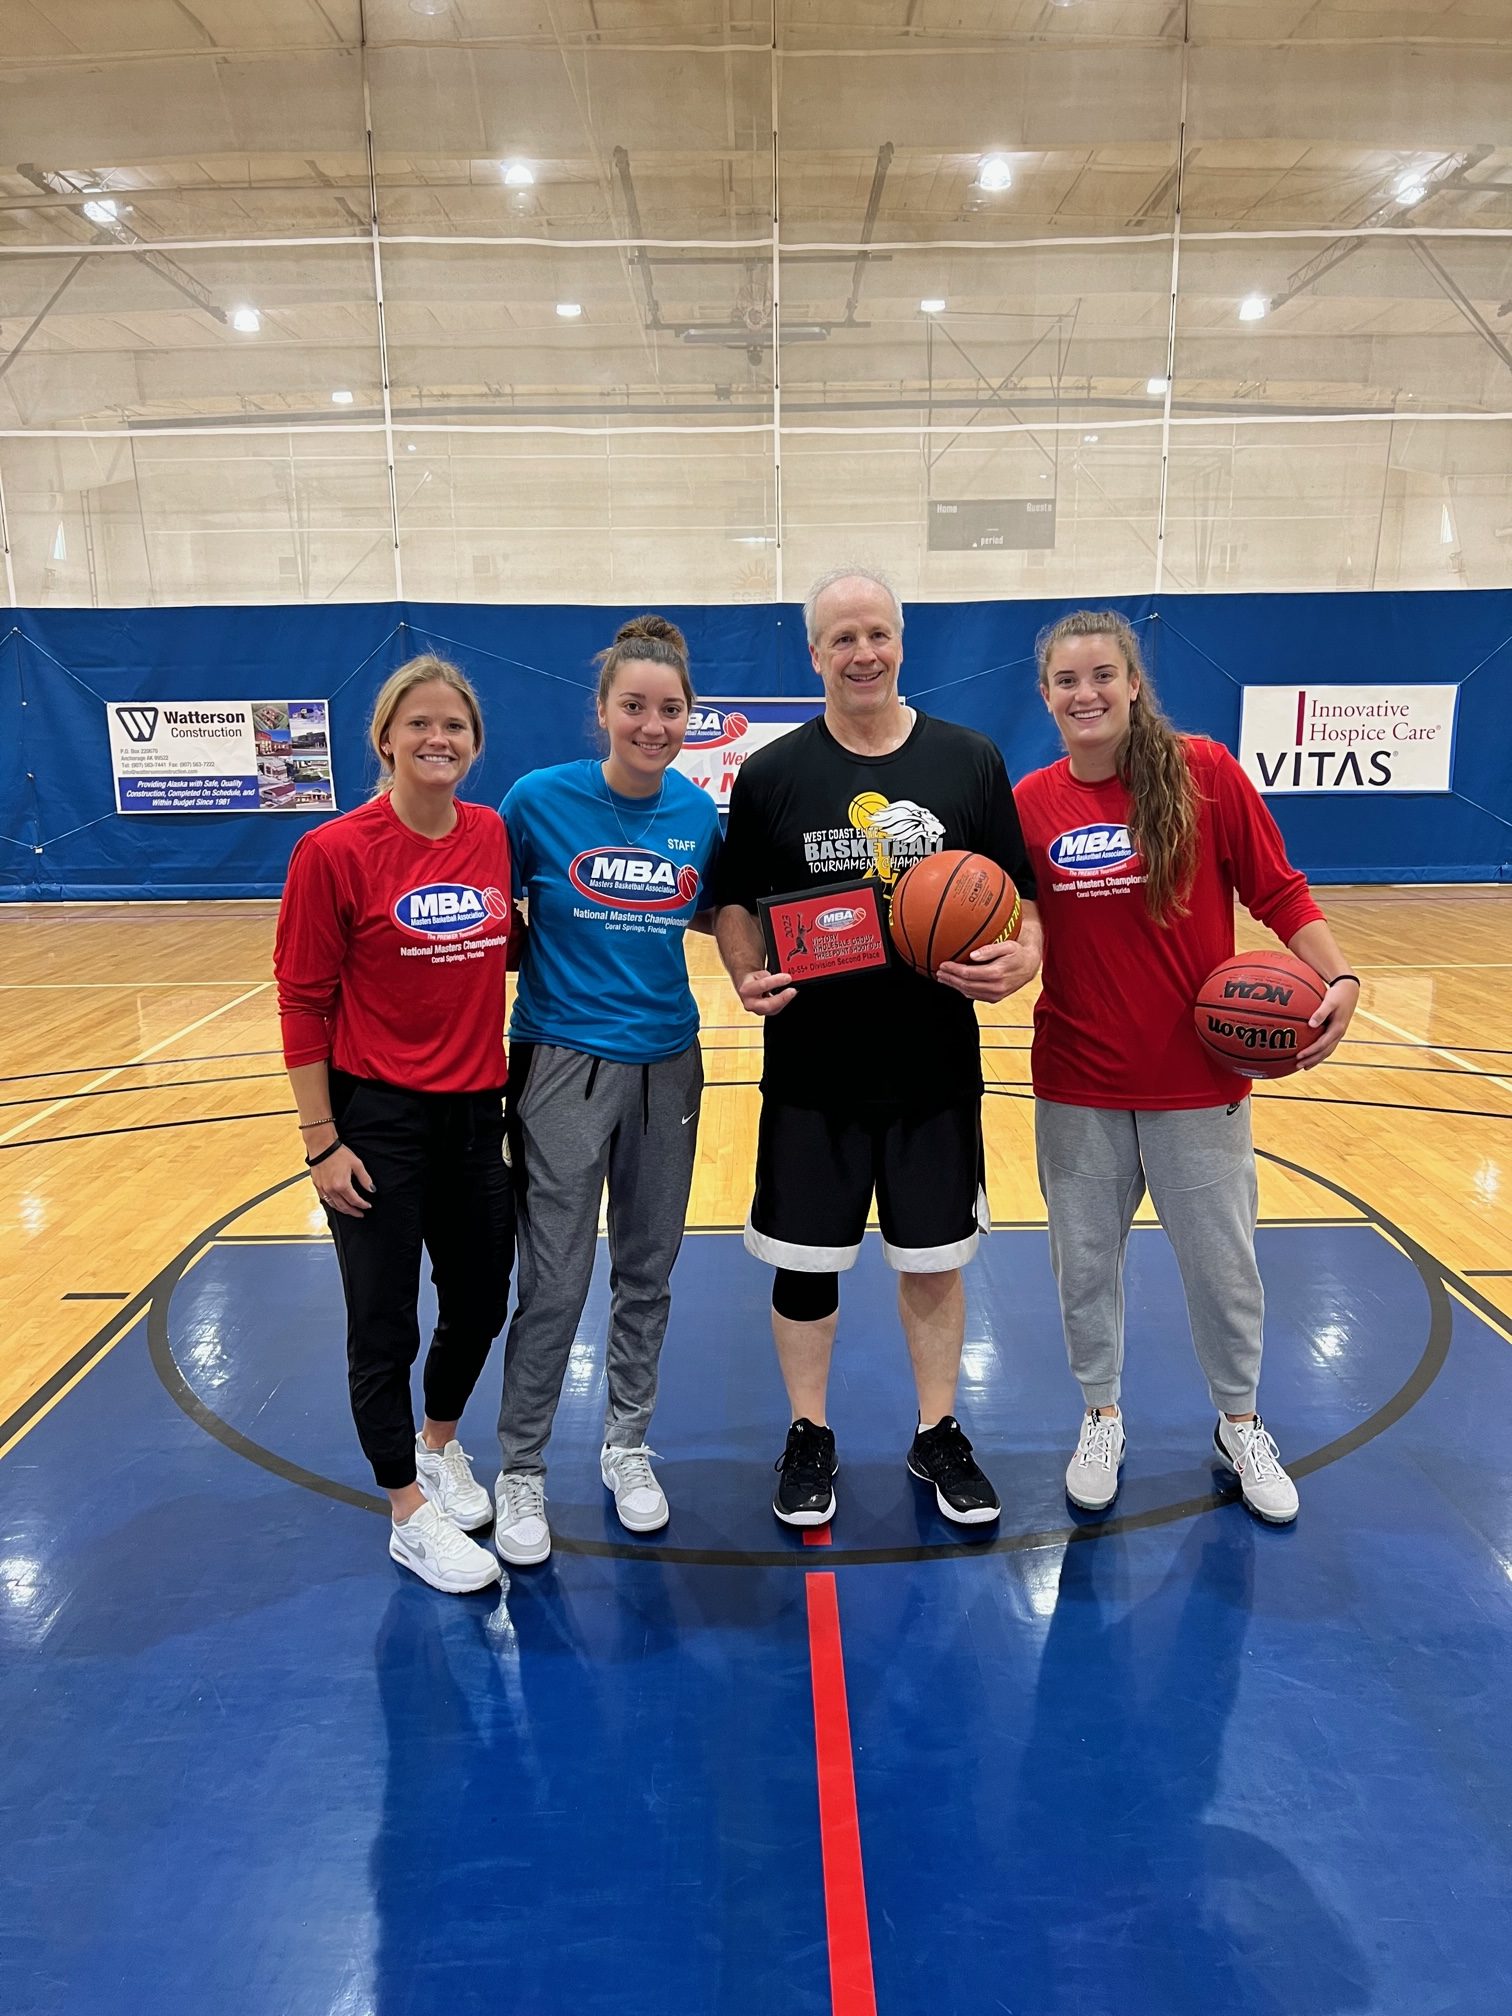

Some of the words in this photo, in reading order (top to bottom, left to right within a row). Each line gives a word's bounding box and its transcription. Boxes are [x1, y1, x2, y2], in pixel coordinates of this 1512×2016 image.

[937, 503, 957, 513] Home
[980, 535, 1004, 546] period
[1311, 700, 1410, 717] Innovative
[164, 711, 246, 724] Watterson
[686, 713, 721, 730] BA
[171, 727, 242, 738] Construction
[1309, 723, 1386, 747] Hospice
[137, 781, 166, 789] Providing
[167, 780, 188, 788] Alaska
[204, 780, 219, 788] Safe,
[221, 780, 243, 788] Quality
[126, 790, 167, 798] Construction,
[168, 789, 201, 798] Completed
[212, 789, 241, 797] Schedule,
[243, 788, 255, 796] and
[173, 799, 195, 807] Budget
[196, 798, 213, 806] Since
[803, 830, 827, 844] WEST
[828, 828, 855, 839] COAST
[667, 838, 696, 851] STAFF
[1058, 829, 1131, 857] MBA
[1102, 850, 1132, 859] Association
[590, 857, 675, 886] MBA
[589, 879, 613, 889] Masters
[614, 881, 644, 891] Basketball
[645, 884, 676, 894] Association
[1052, 881, 1076, 892] National
[1076, 879, 1105, 890] Masters
[1090, 889, 1112, 897] Springs,
[410, 890, 483, 918] MBA
[410, 918, 431, 926] Masters
[432, 915, 456, 924] Basketball
[457, 912, 485, 920] Association
[573, 908, 608, 920] National
[609, 911, 643, 922] Masters
[823, 910, 854, 924] MBA
[605, 922, 621, 930] Coral
[622, 923, 646, 933] Springs,
[647, 926, 667, 934] Florida
[400, 945, 433, 956] National
[434, 943, 462, 954] Masters
[813, 940, 850, 953] WHOLESALE
[431, 956, 445, 964] Coral
[446, 953, 467, 963] Springs,
[467, 951, 484, 959] Florida
[809, 960, 836, 970] Division
[837, 955, 861, 966] Second
[863, 952, 880, 961] Place
[1224, 980, 1294, 1007] NCAA
[1206, 1015, 1298, 1050] Wilson
